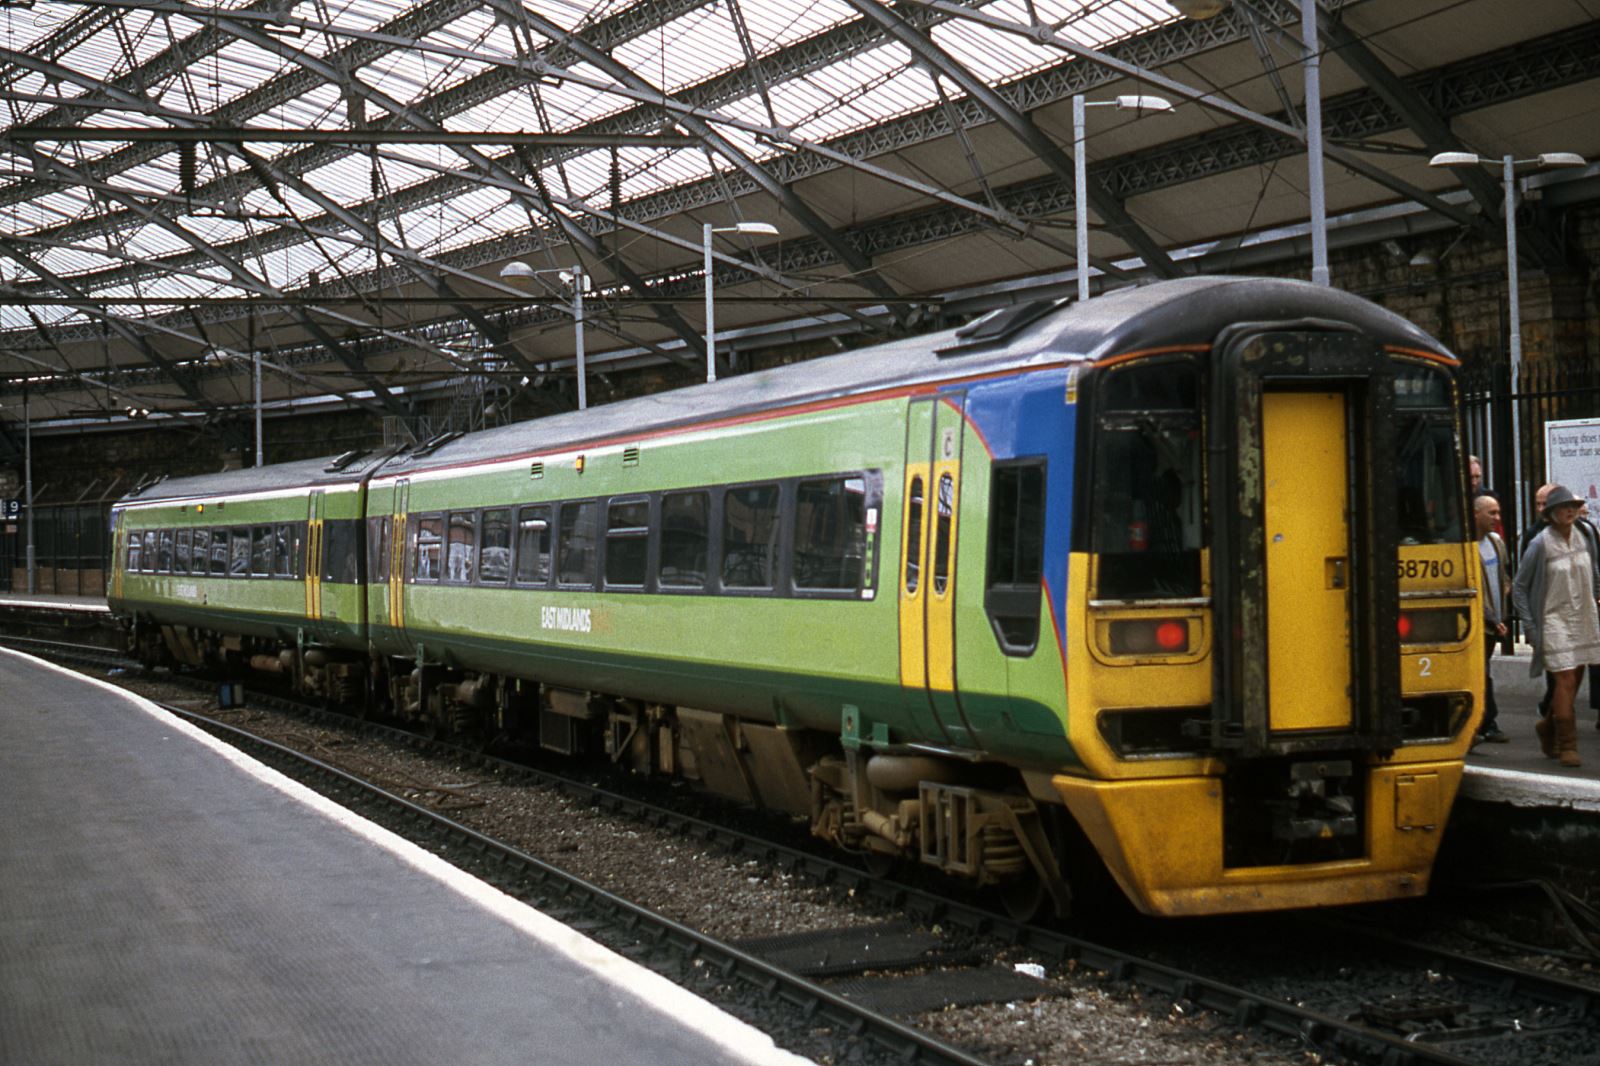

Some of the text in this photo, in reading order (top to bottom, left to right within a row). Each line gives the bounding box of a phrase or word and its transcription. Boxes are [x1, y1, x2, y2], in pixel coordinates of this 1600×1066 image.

[10, 500, 19, 512] 9
[541, 606, 591, 633] EAST MIDLANDS
[1418, 656, 1431, 677] 2
